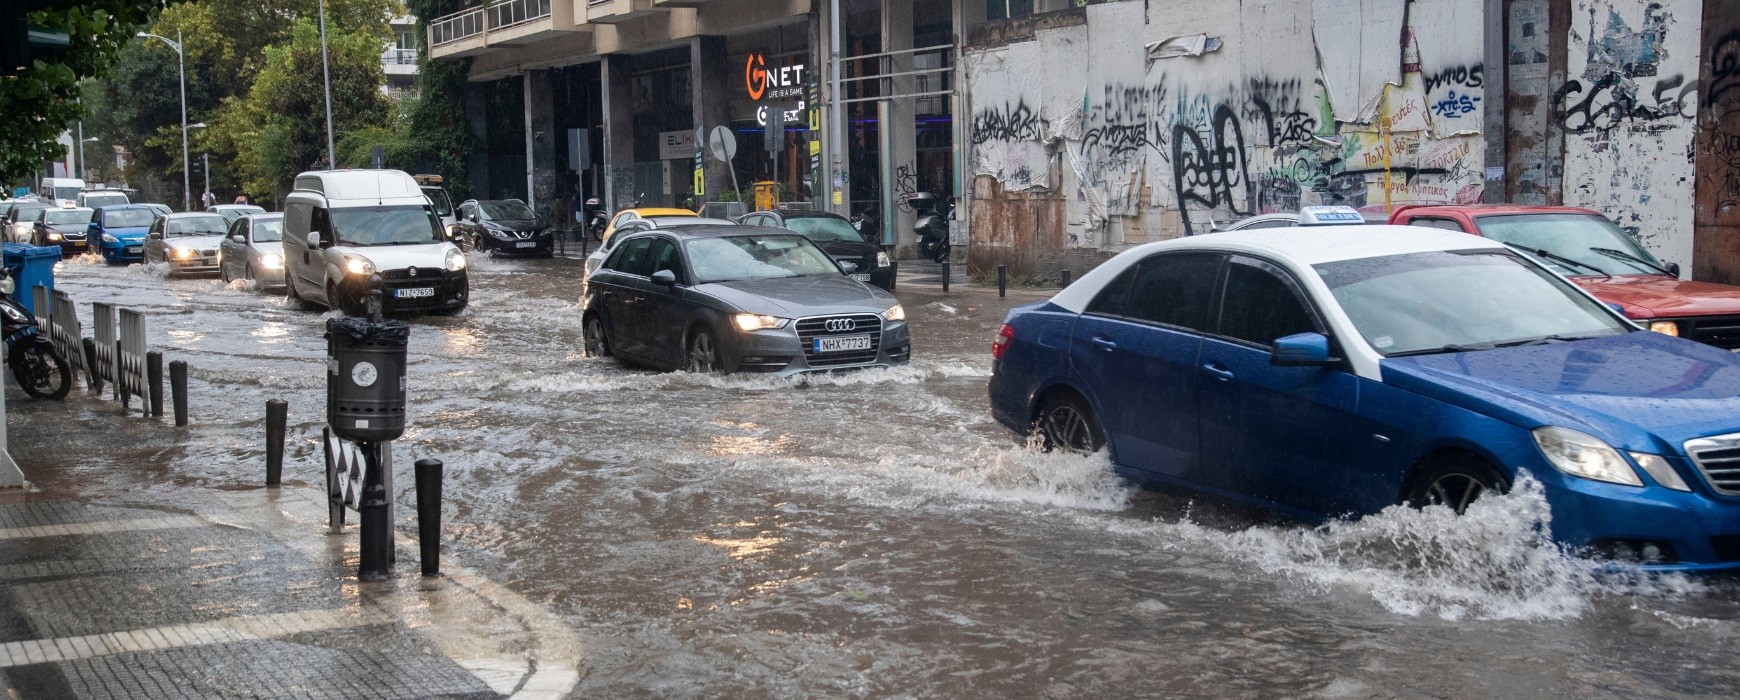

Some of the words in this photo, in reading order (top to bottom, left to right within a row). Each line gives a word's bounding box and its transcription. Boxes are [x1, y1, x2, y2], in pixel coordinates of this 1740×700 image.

[768, 90, 778, 98] LIFE
[779, 89, 784, 97] IS
[790, 87, 803, 95] GAME
[1363, 145, 1392, 167] Πολλ
[1377, 176, 1409, 194] Γιργος
